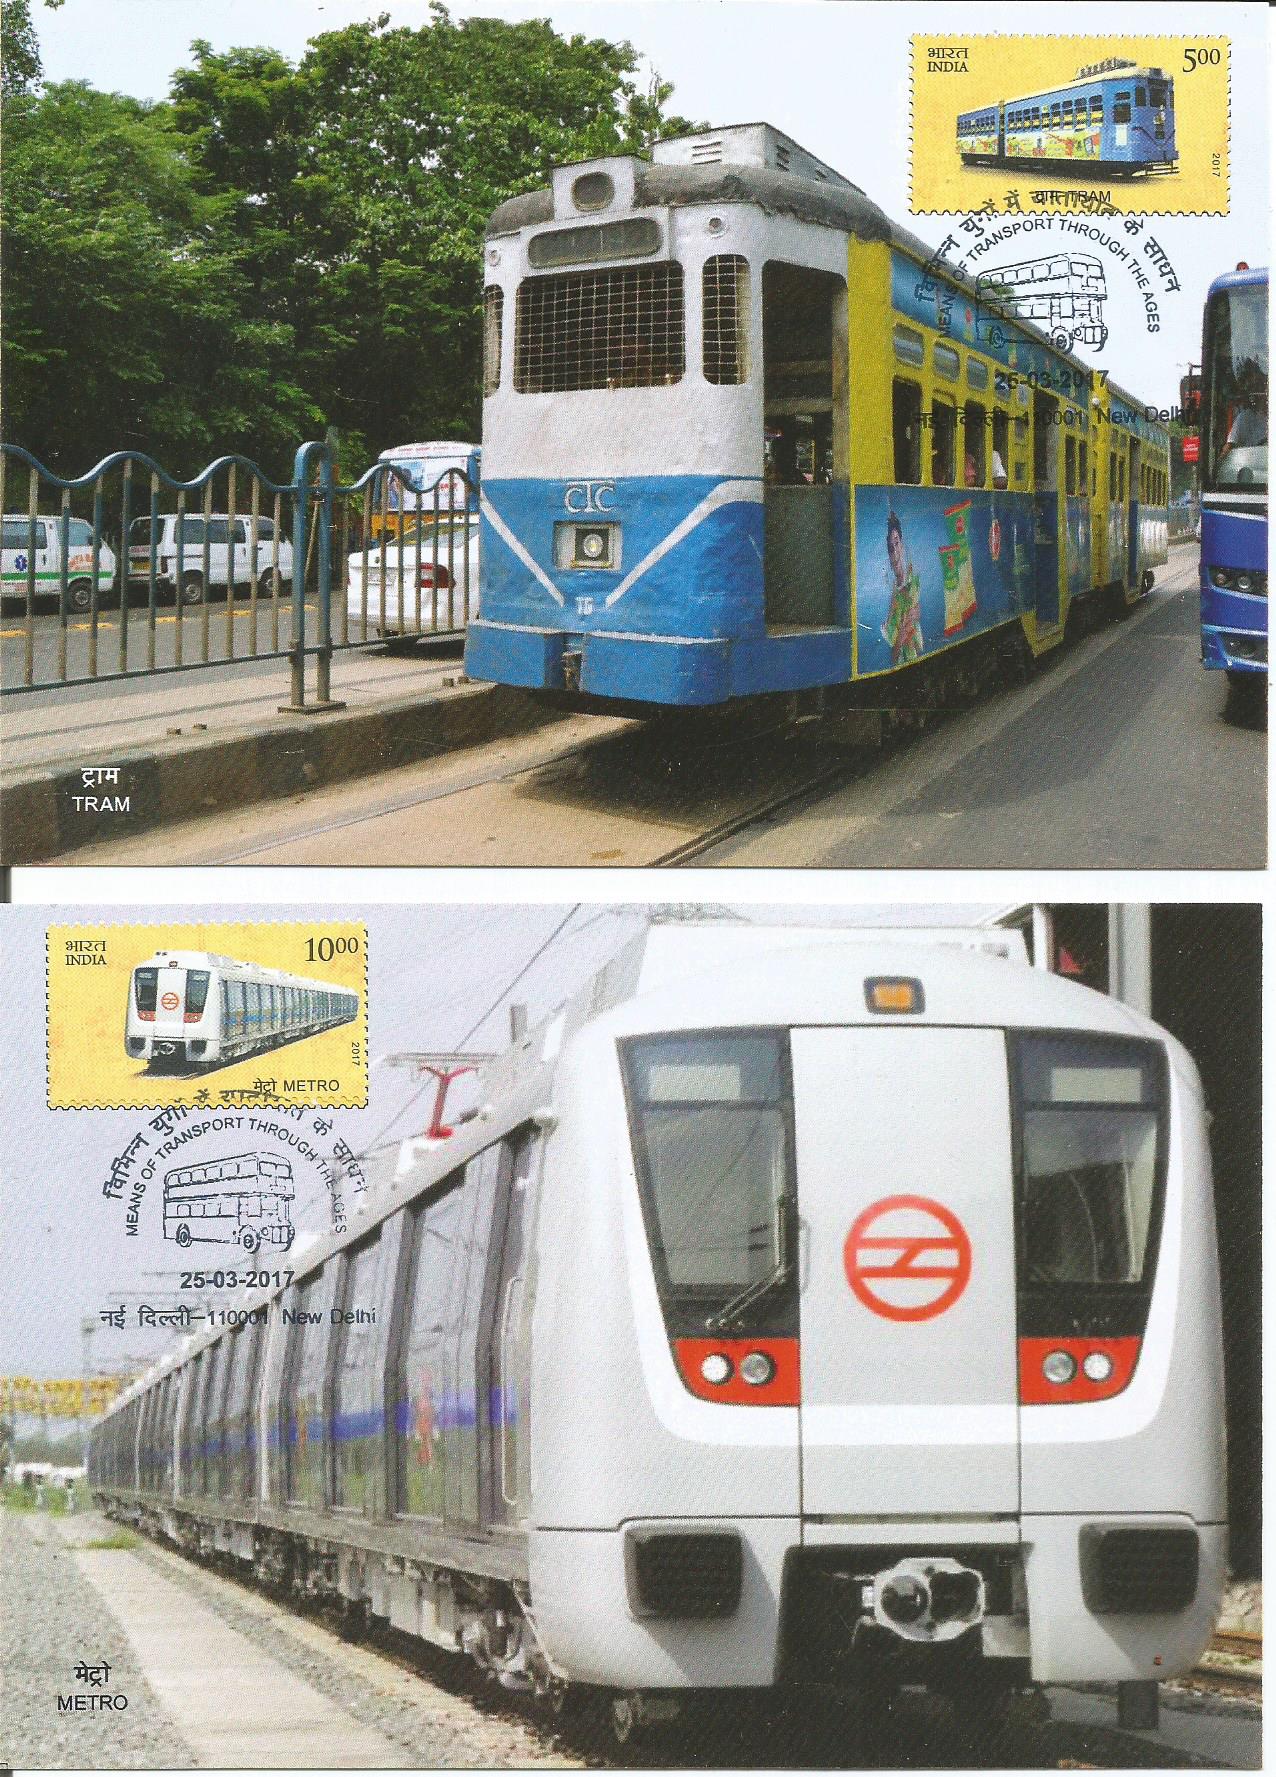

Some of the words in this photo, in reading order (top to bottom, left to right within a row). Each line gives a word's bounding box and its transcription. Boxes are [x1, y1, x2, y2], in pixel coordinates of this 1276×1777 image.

[927, 47, 969, 59] भारत
[1182, 48, 1220, 72] 500
[927, 61, 969, 73] INDIA
[1212, 153, 1221, 177] 2017
[1067, 190, 1111, 202] TRAM
[1123, 217, 1144, 236] के
[1144, 236, 1181, 293] साधन
[953, 260, 968, 282] OF
[966, 218, 1055, 262] TRANSPORT
[1059, 219, 1130, 261] THROUGH
[1127, 259, 1150, 289] THE
[1142, 292, 1160, 333] AGES
[1097, 407, 1137, 424] New
[1145, 405, 1189, 422] Delh
[65, 940, 106, 952] भारत
[305, 937, 359, 962] 1000
[65, 954, 107, 966] INDIA
[351, 1041, 360, 1066] 2017
[253, 1078, 277, 1096] मेट्रो
[283, 1079, 340, 1092] METRO
[102, 1132, 149, 1199] विभिन्न
[313, 1116, 334, 1136] के
[126, 1182, 147, 1237] MEANS
[141, 1158, 157, 1180] OF
[155, 1117, 244, 1159] TRANSPORT
[249, 1118, 319, 1161] THROUGH
[316, 1160, 338, 1189] THE
[331, 1193, 347, 1234] AGES
[180, 1270, 295, 1289] 25-03-2017
[99, 1305, 126, 1329] नई
[282, 1309, 322, 1324] New
[330, 1307, 376, 1324] Delhi
